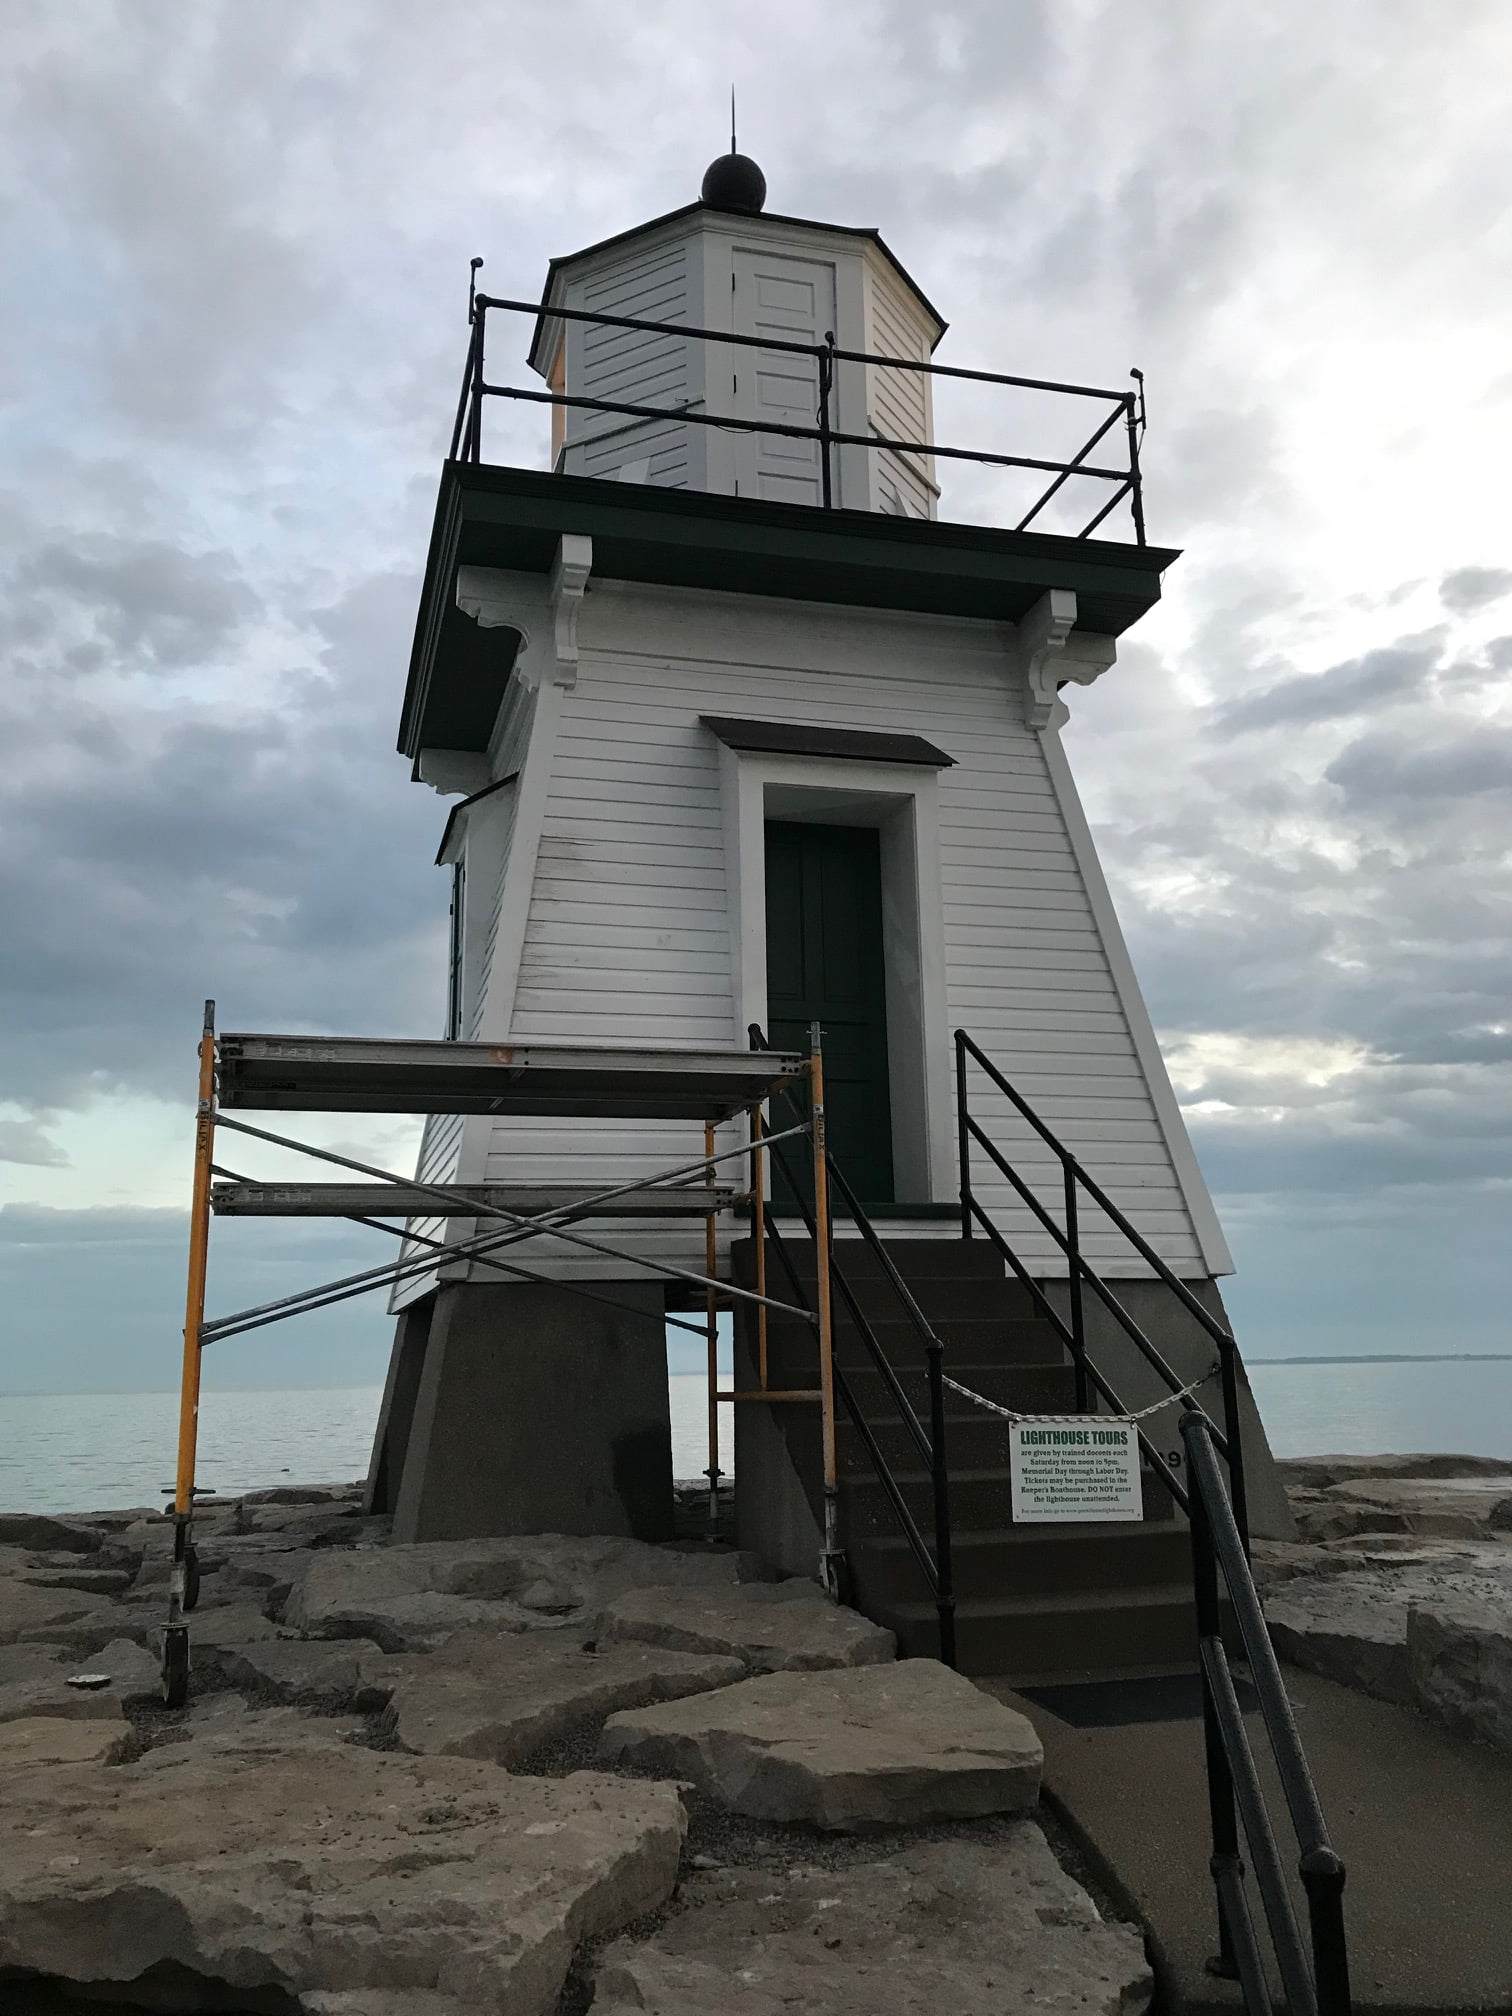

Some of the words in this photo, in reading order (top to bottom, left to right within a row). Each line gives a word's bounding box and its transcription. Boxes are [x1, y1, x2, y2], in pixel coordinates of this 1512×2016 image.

[1020, 1430, 1090, 1445] LIGHTHOUSE
[1091, 1430, 1128, 1445] TOURS
[1033, 1449, 1052, 1457] given
[1053, 1449, 1061, 1457] by
[1030, 1459, 1060, 1467] Saturday
[1055, 1468, 1068, 1476] Day
[1069, 1468, 1095, 1476] through
[1075, 1477, 1108, 1485] purchased
[1021, 1486, 1049, 1495] Keeper's
[1046, 1495, 1080, 1504] lighthouse
